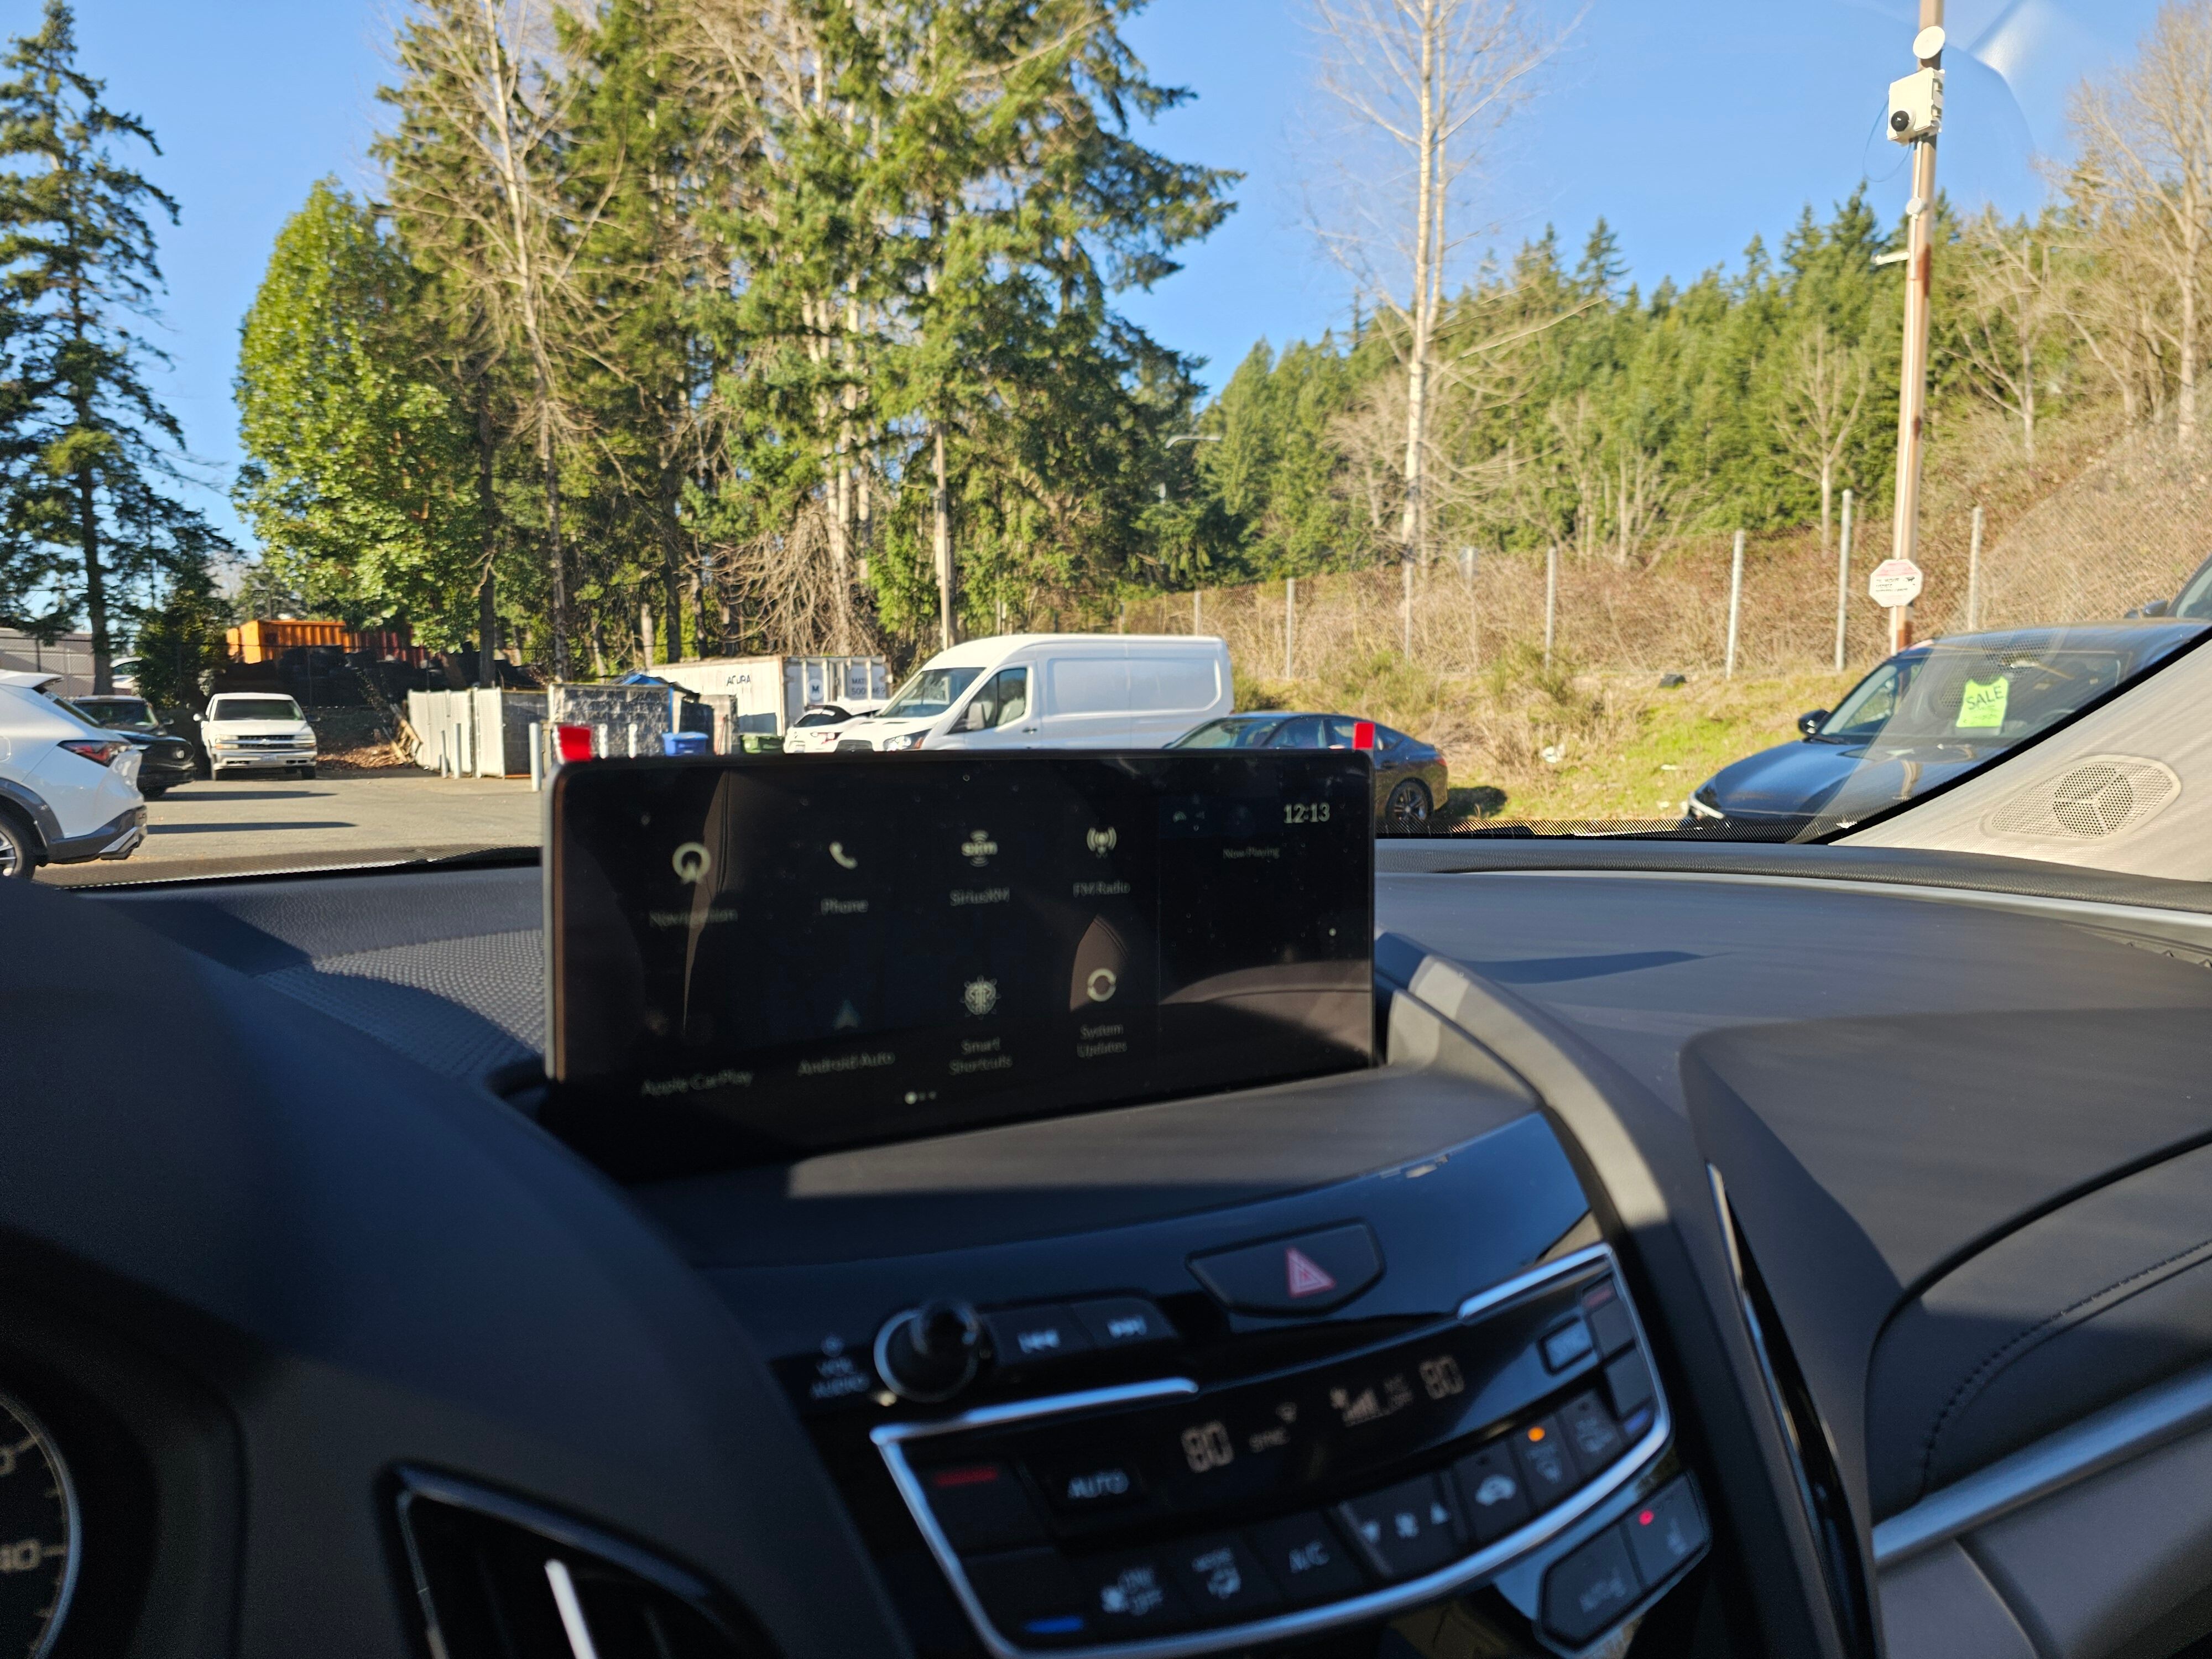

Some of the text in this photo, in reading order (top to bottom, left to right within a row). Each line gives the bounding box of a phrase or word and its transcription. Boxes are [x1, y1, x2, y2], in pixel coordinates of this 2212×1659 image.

[726, 674, 751, 686] ACURA
[1965, 685, 2004, 710] SALE
[1283, 802, 1331, 823] 12:13
[1096, 880, 1131, 896] Radio
[821, 898, 869, 915] Phone
[797, 1051, 896, 1077] Android Auto
[1181, 1421, 1234, 1474] 80
[1067, 1469, 1130, 1500] AUTO
